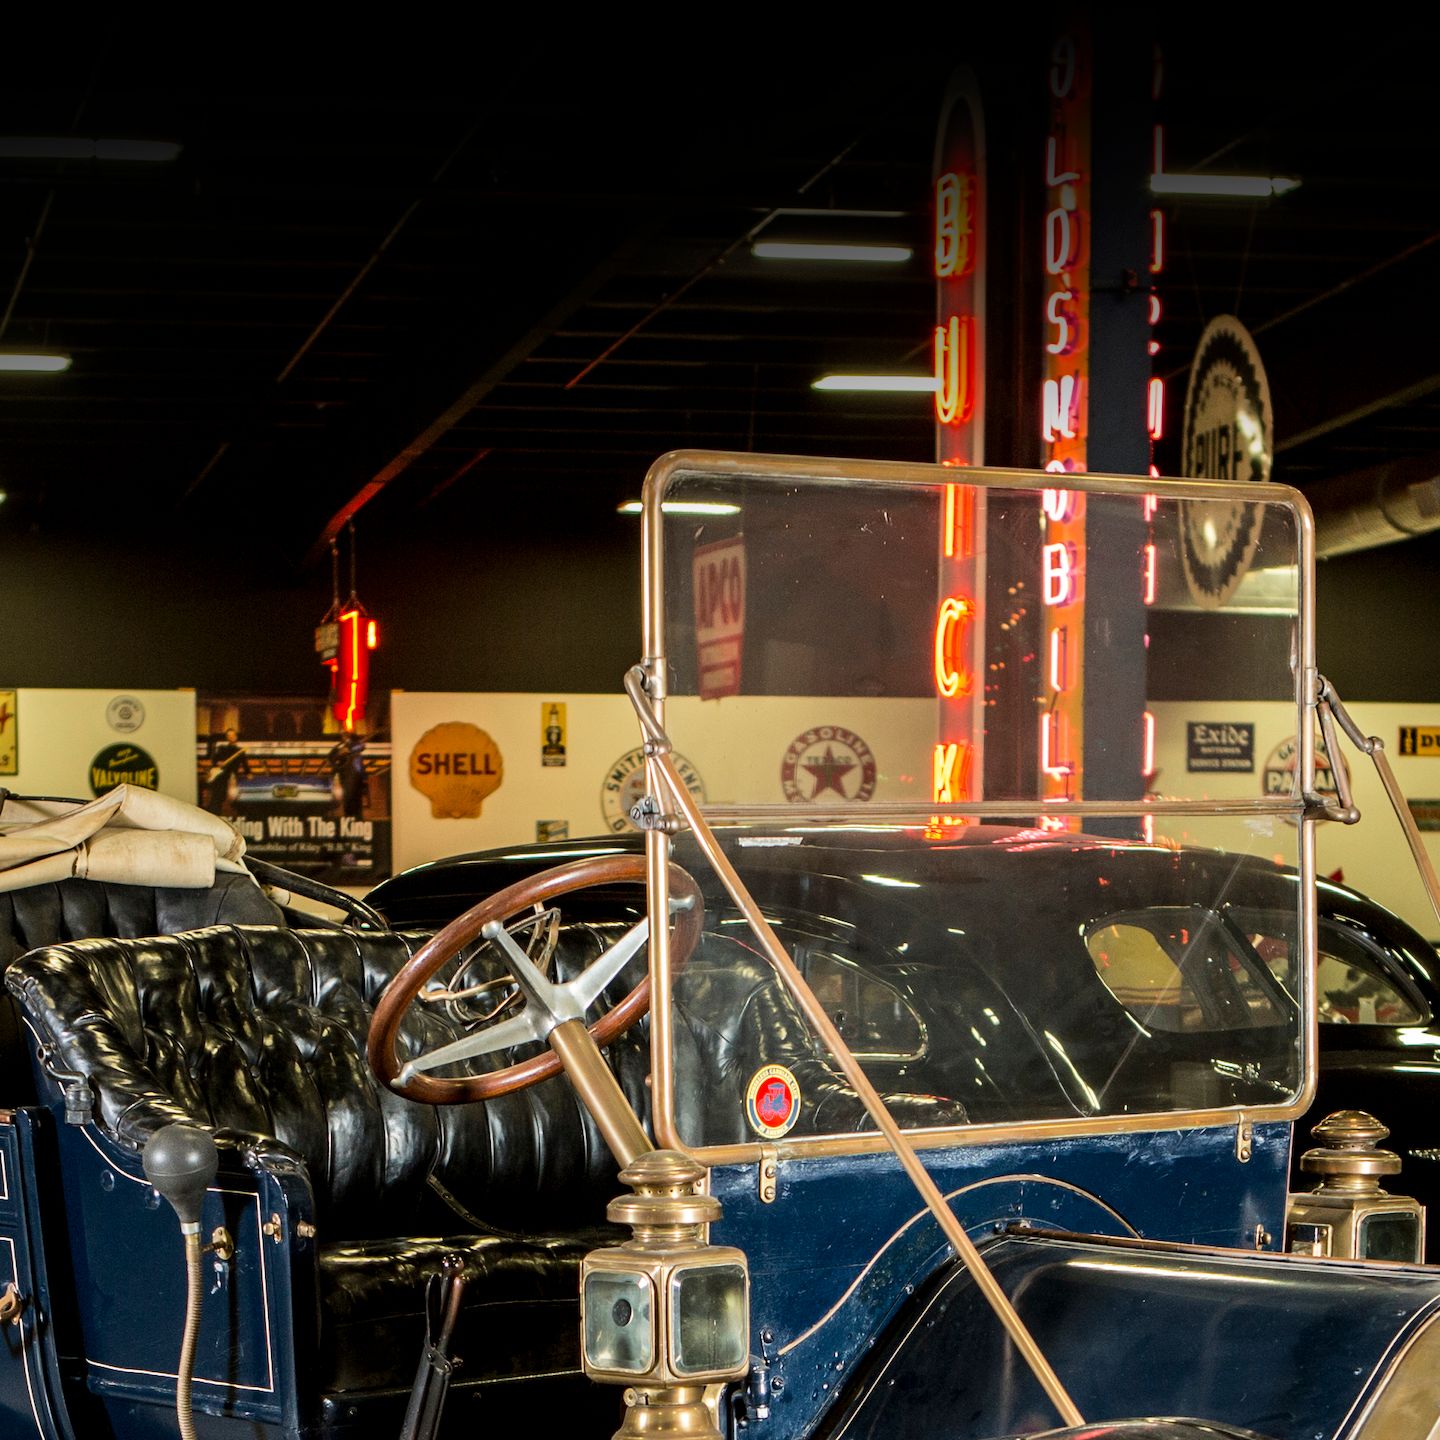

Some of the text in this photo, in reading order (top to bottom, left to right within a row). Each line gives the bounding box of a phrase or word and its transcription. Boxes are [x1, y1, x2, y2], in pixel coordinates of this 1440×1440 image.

[933, 171, 974, 838] BUICK
[1194, 725, 1250, 745] Exide
[416, 753, 496, 776] SHELL
[92, 767, 157, 789] VALVOLINE
[268, 816, 303, 837] With
[308, 816, 336, 837] The
[340, 816, 373, 841] King
